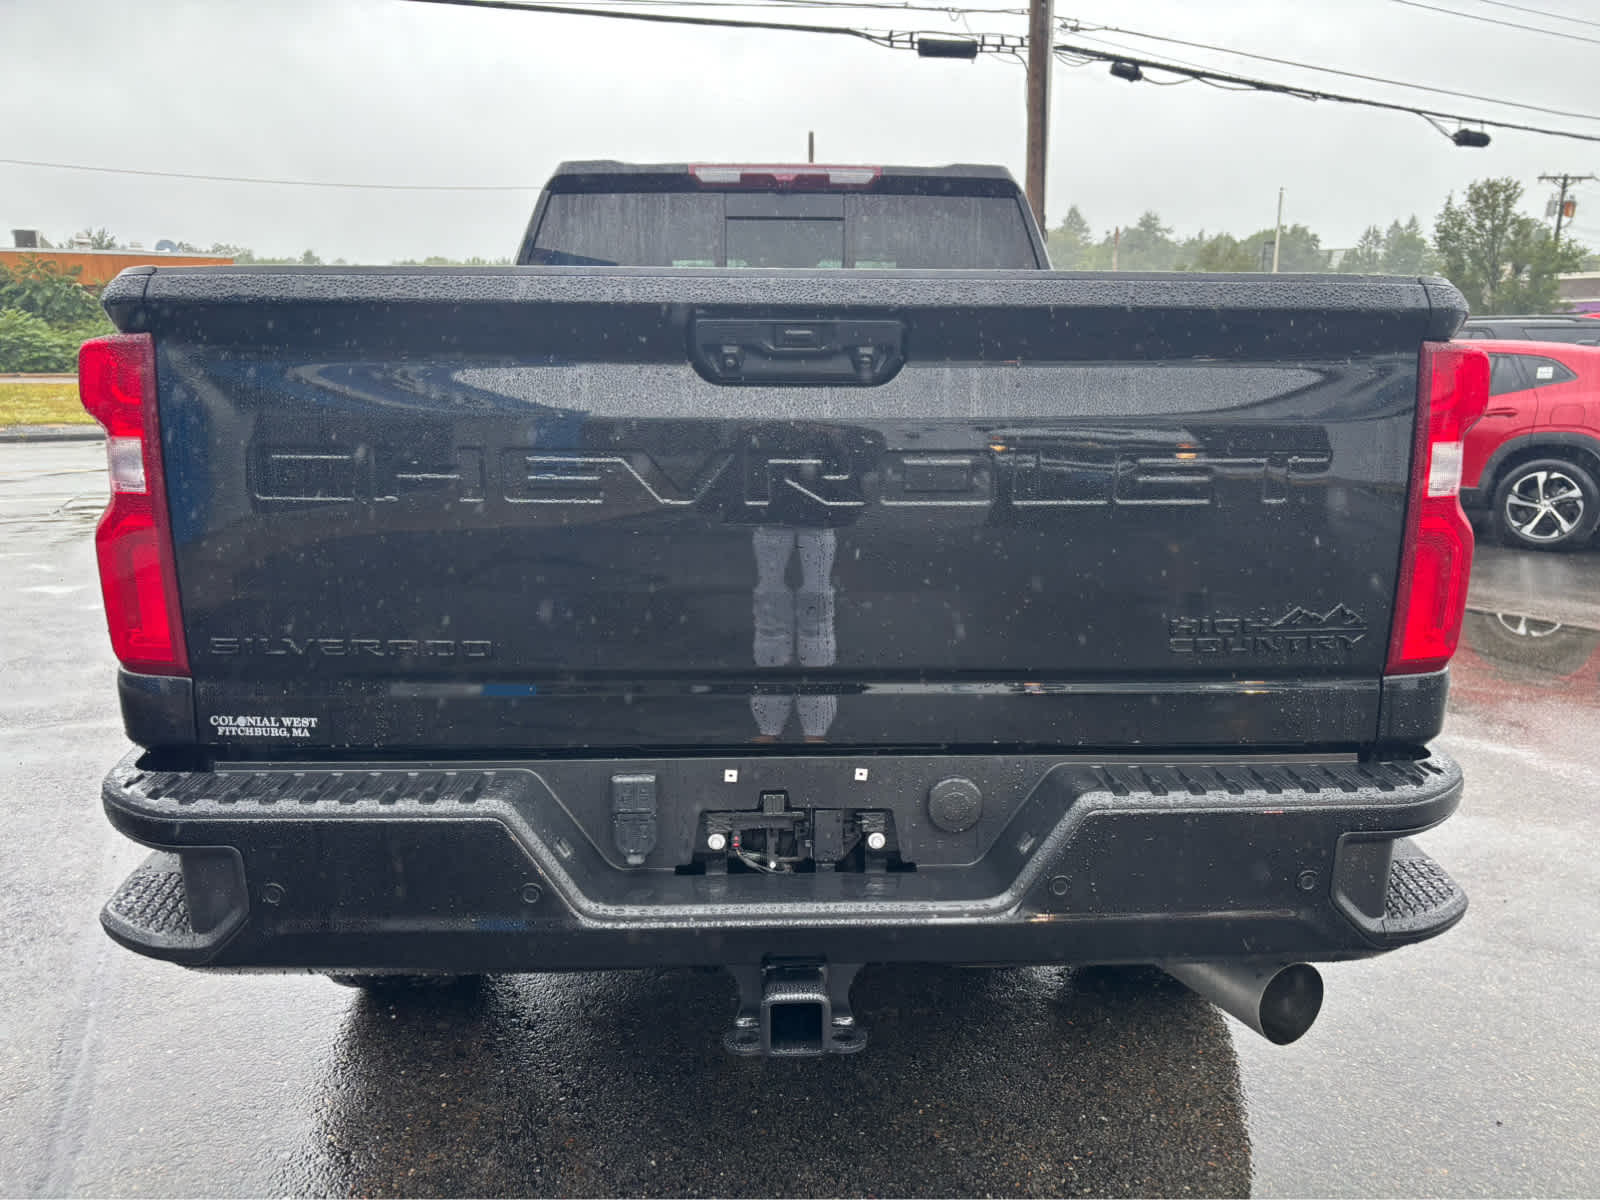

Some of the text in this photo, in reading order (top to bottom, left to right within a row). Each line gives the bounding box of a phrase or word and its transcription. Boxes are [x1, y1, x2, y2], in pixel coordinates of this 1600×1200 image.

[248, 446, 1332, 507] CHEVROLET
[209, 636, 493, 657] SILVERADO
[1168, 634, 1367, 652] COUNTRY
[209, 715, 318, 728] COLONIAL WEST
[217, 726, 310, 738] FITCHBURG, MA
